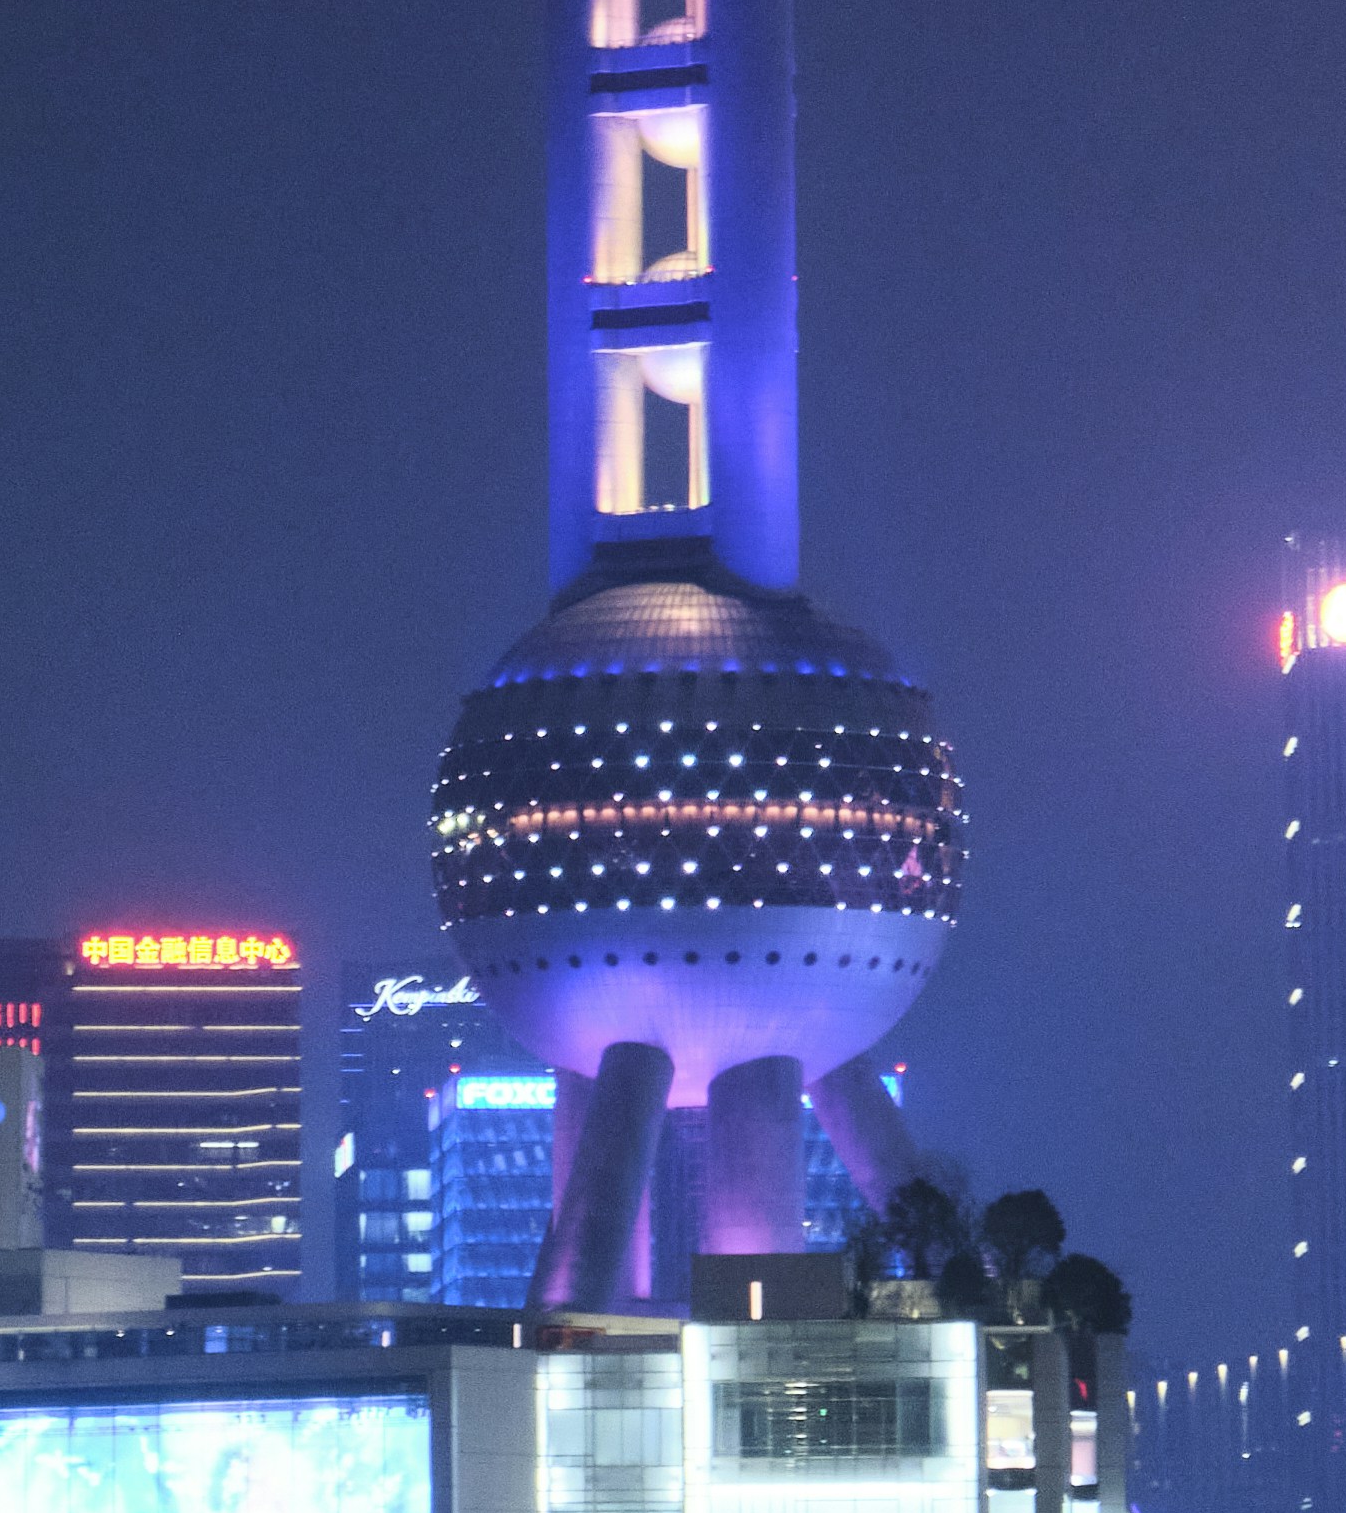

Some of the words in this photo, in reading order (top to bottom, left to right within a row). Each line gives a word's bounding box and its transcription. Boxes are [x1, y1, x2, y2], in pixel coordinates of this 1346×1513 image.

[82, 936, 291, 964] 中国金融信息中心
[355, 976, 480, 1015] Kempinski
